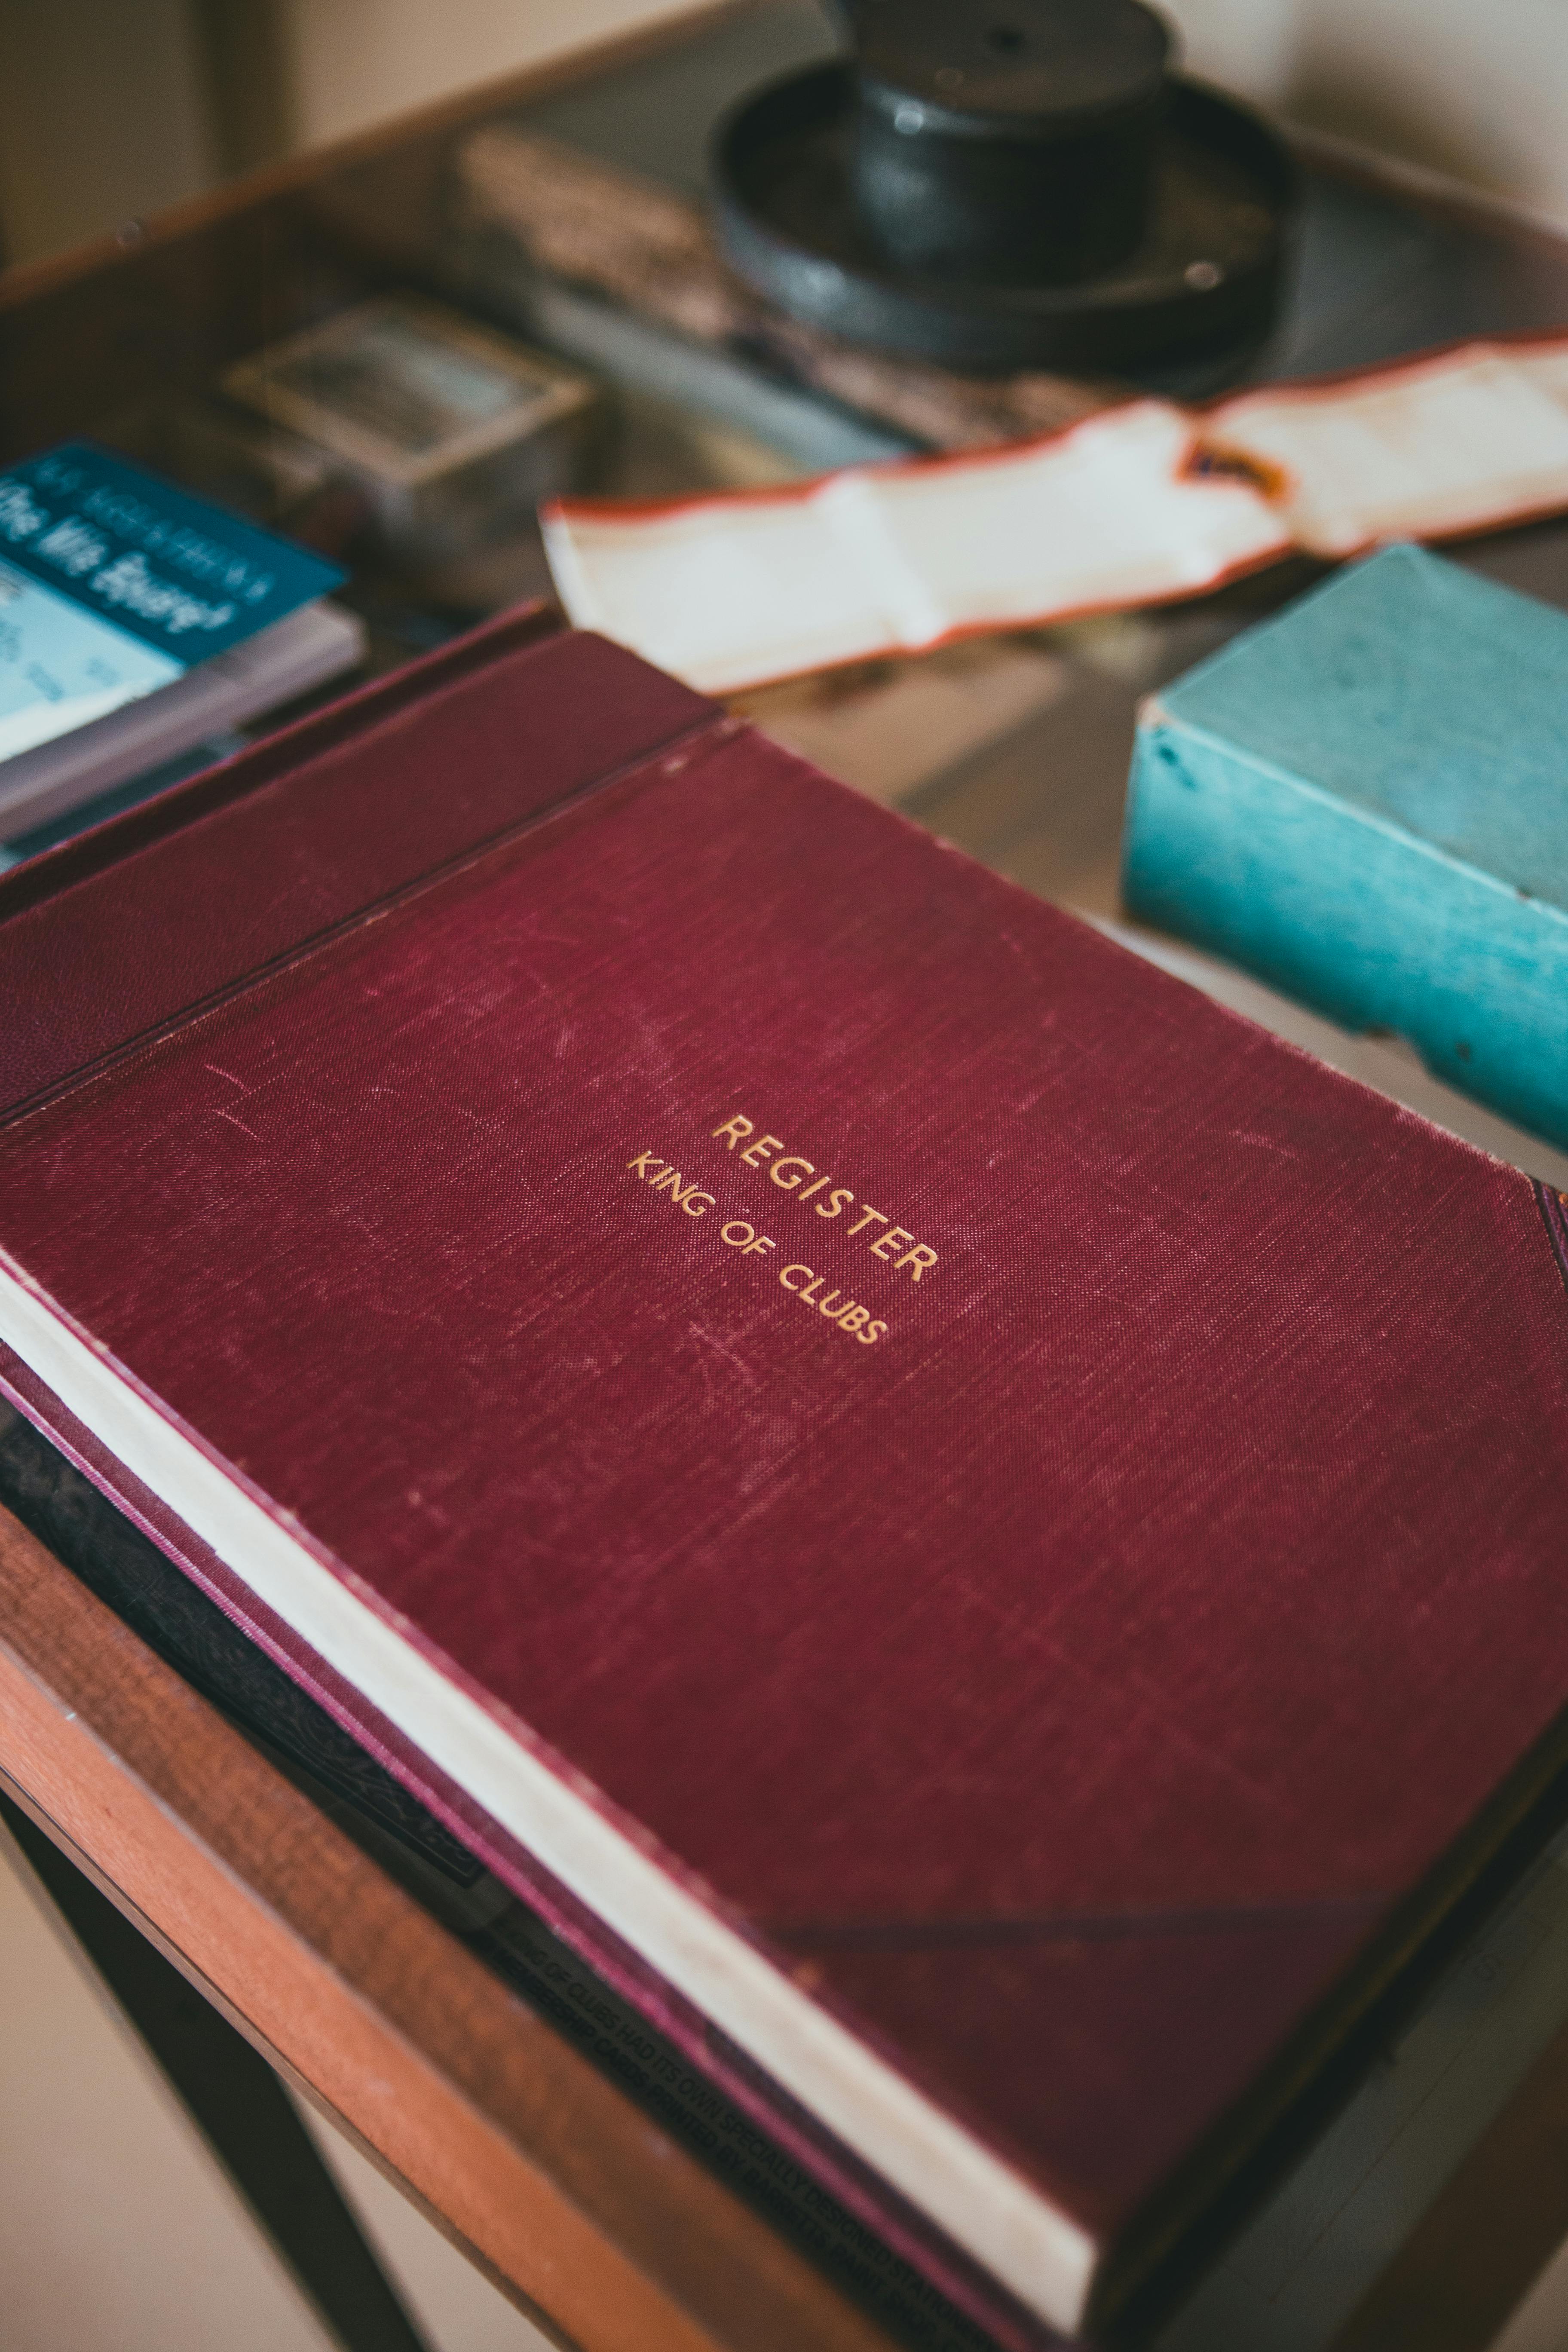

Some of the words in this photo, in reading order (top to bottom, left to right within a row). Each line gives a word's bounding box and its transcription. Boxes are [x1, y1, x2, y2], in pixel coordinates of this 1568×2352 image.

[626, 1151, 716, 1216] KING
[720, 1221, 775, 1255] OF
[779, 1264, 887, 1344] CLUBS
[711, 1115, 937, 1282] REGISTER
[493, 1948, 596, 2039] MEMBERSHIP
[595, 2038, 649, 2088] CARDS
[648, 2086, 720, 2149] PRINTED
[718, 2146, 744, 2171] BY
[830, 2244, 886, 2295] PAINT
[505, 1930, 548, 1966] KING
[544, 1962, 572, 1984] OF
[567, 1981, 620, 2030] CLUBS
[617, 2024, 655, 2060] HAD
[653, 2055, 682, 2082] ITS
[678, 2077, 724, 2120] OWN
[719, 2113, 808, 2191] SPECIALLY
[804, 2187, 891, 2266] DESIGNED
